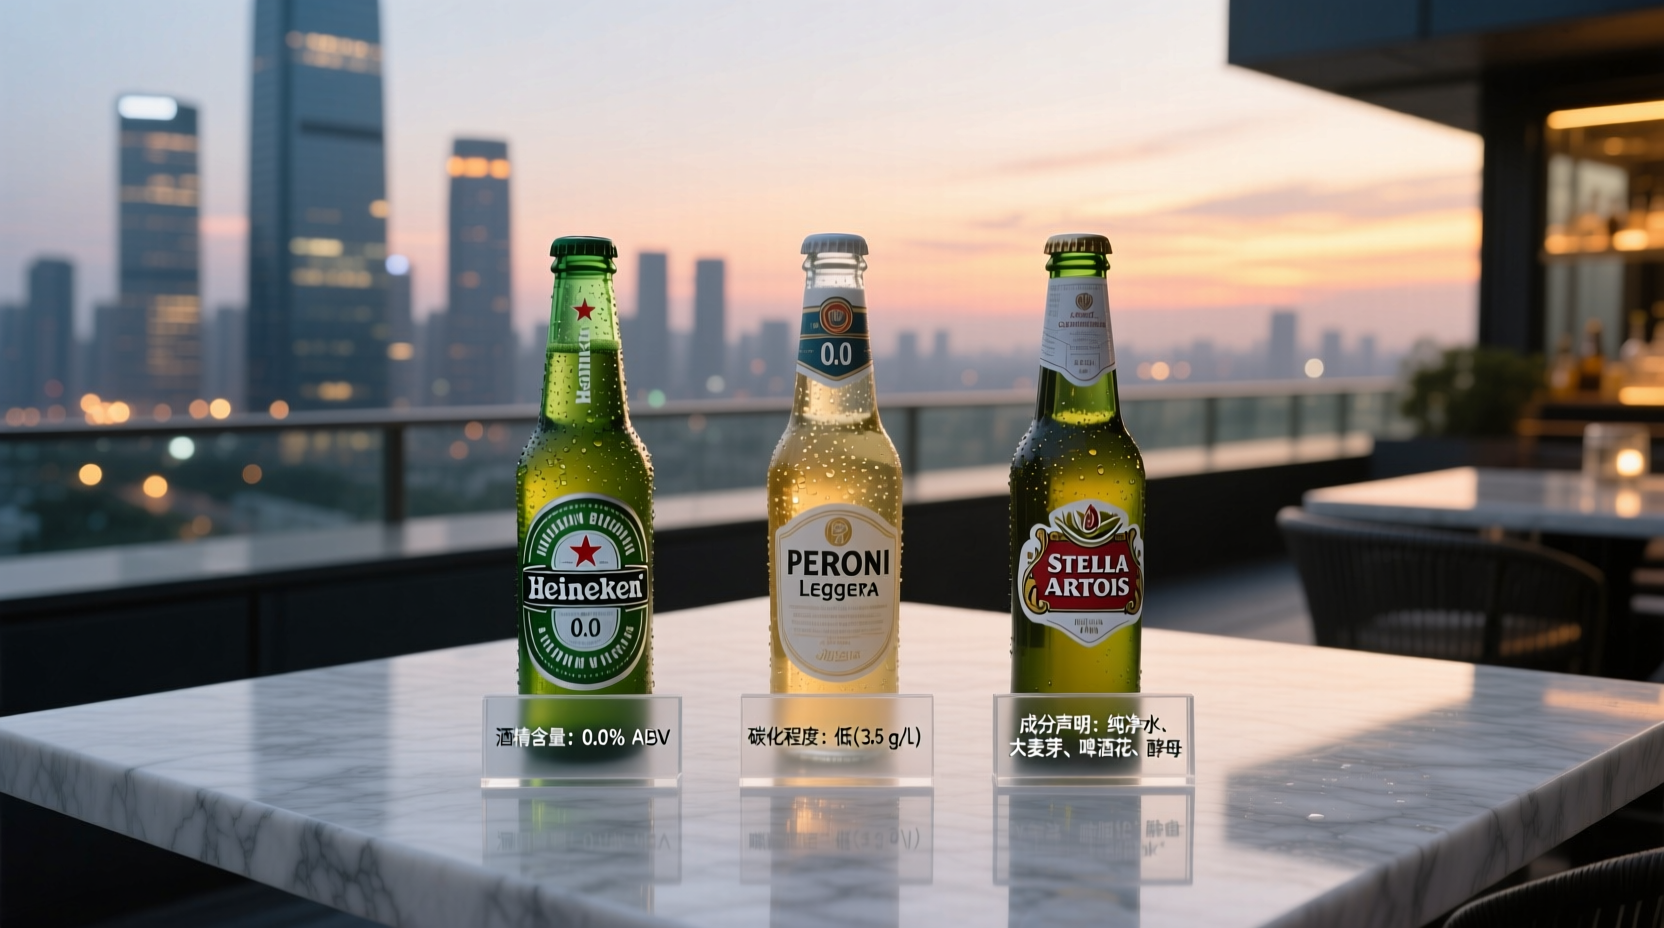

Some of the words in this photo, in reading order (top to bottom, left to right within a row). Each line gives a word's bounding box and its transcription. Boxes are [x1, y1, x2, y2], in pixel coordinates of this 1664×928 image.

[820, 341, 852, 366] 0.0
[787, 549, 889, 576] PERONI
[1047, 553, 1129, 573] STELLA
[528, 574, 643, 601] Heineken
[1044, 577, 1129, 597] ARTOIS
[570, 617, 601, 638] 0.0
[632, 729, 671, 746] ABV
